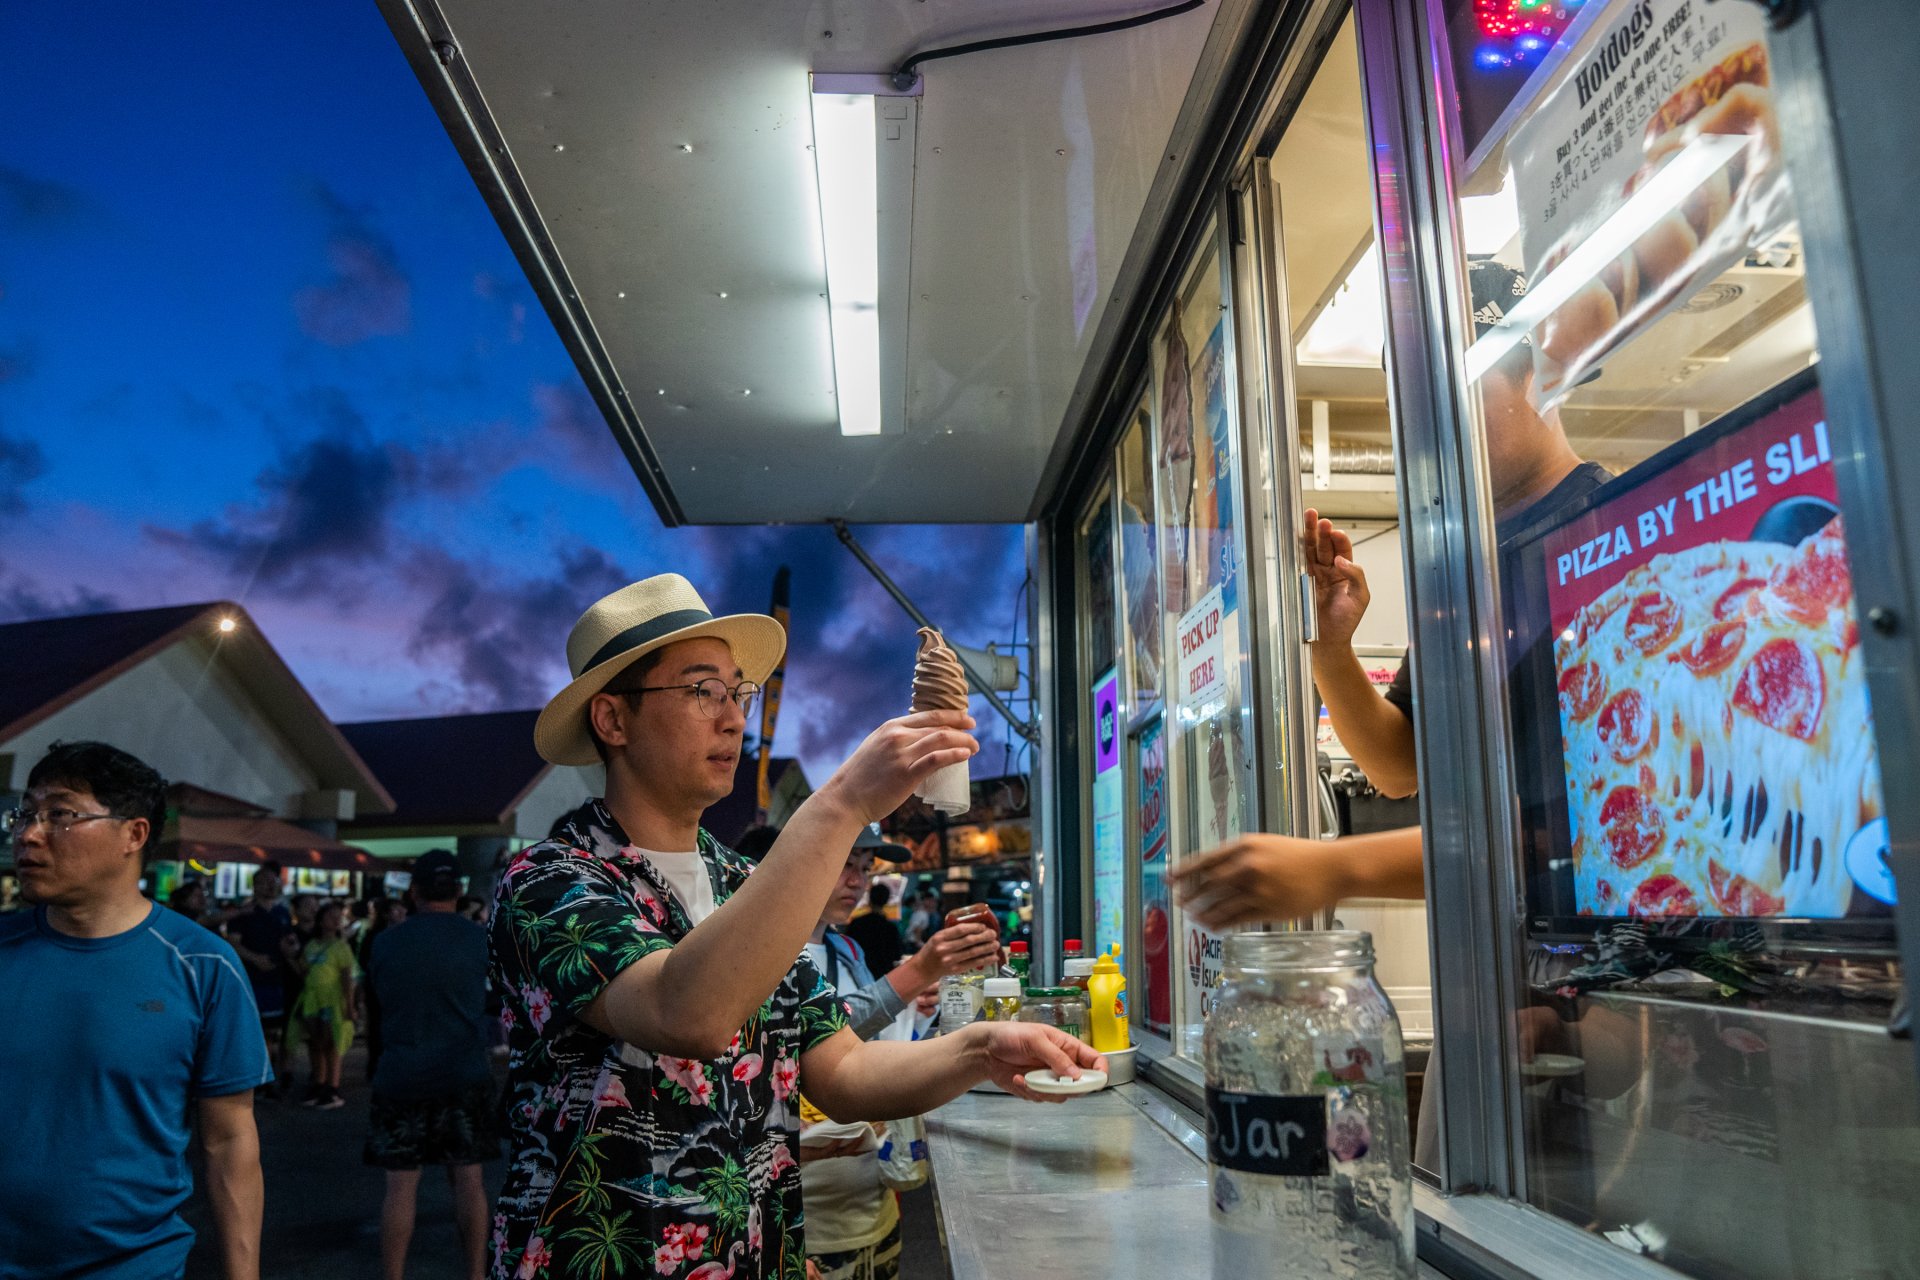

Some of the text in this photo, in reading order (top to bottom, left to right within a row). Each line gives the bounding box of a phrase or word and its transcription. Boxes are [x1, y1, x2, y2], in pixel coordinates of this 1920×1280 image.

[1556, 138, 1571, 163] Buy
[1573, 128, 1579, 145] 3
[1580, 108, 1597, 137] and
[1598, 91, 1614, 120] get
[1614, 76, 1628, 101] the
[1643, 36, 1661, 65] one
[1662, 1, 1692, 42] FREE!
[1575, 0, 1654, 110] Hotdogs
[1557, 421, 1831, 587] PIZZA BY THE SLI
[1181, 607, 1219, 659] PICK UP
[1189, 655, 1215, 695] HERE
[1201, 932, 1225, 959] PACIF
[1218, 1094, 1305, 1160] Jar
